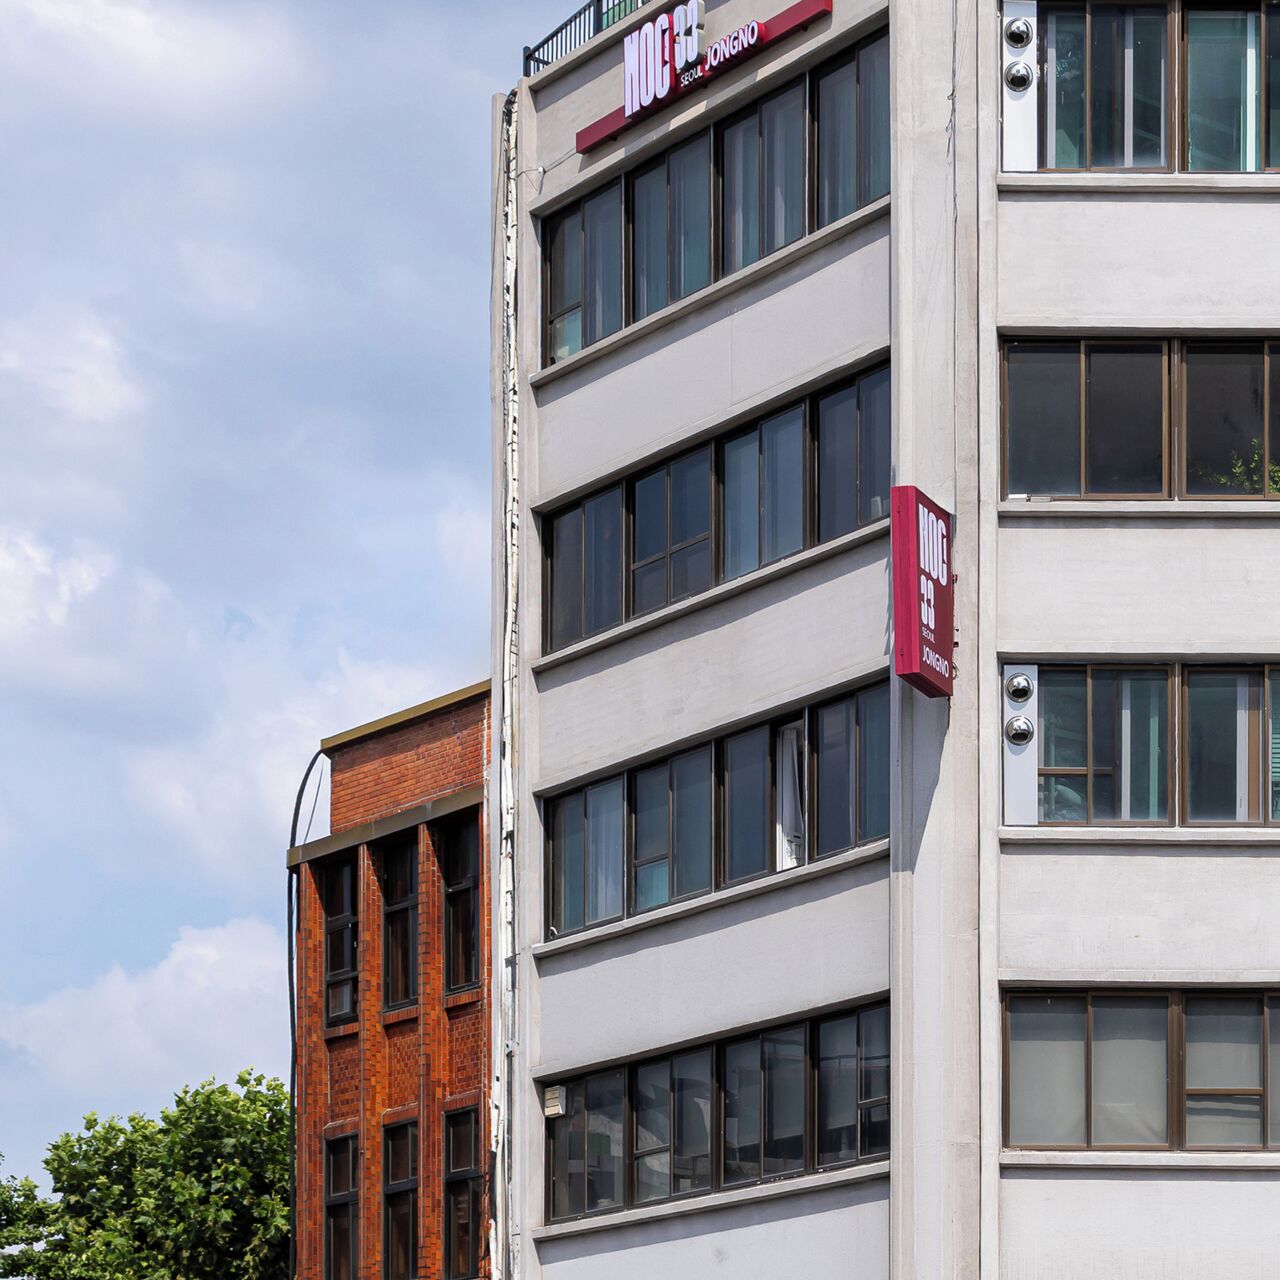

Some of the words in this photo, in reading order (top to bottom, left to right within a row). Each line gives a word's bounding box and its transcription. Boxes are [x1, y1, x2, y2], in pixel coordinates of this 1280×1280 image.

[680, 64, 704, 88] SEOUL
[704, 19, 759, 70] JONGNO
[921, 625, 936, 644] SEOUL
[922, 643, 950, 679] JONGNO
